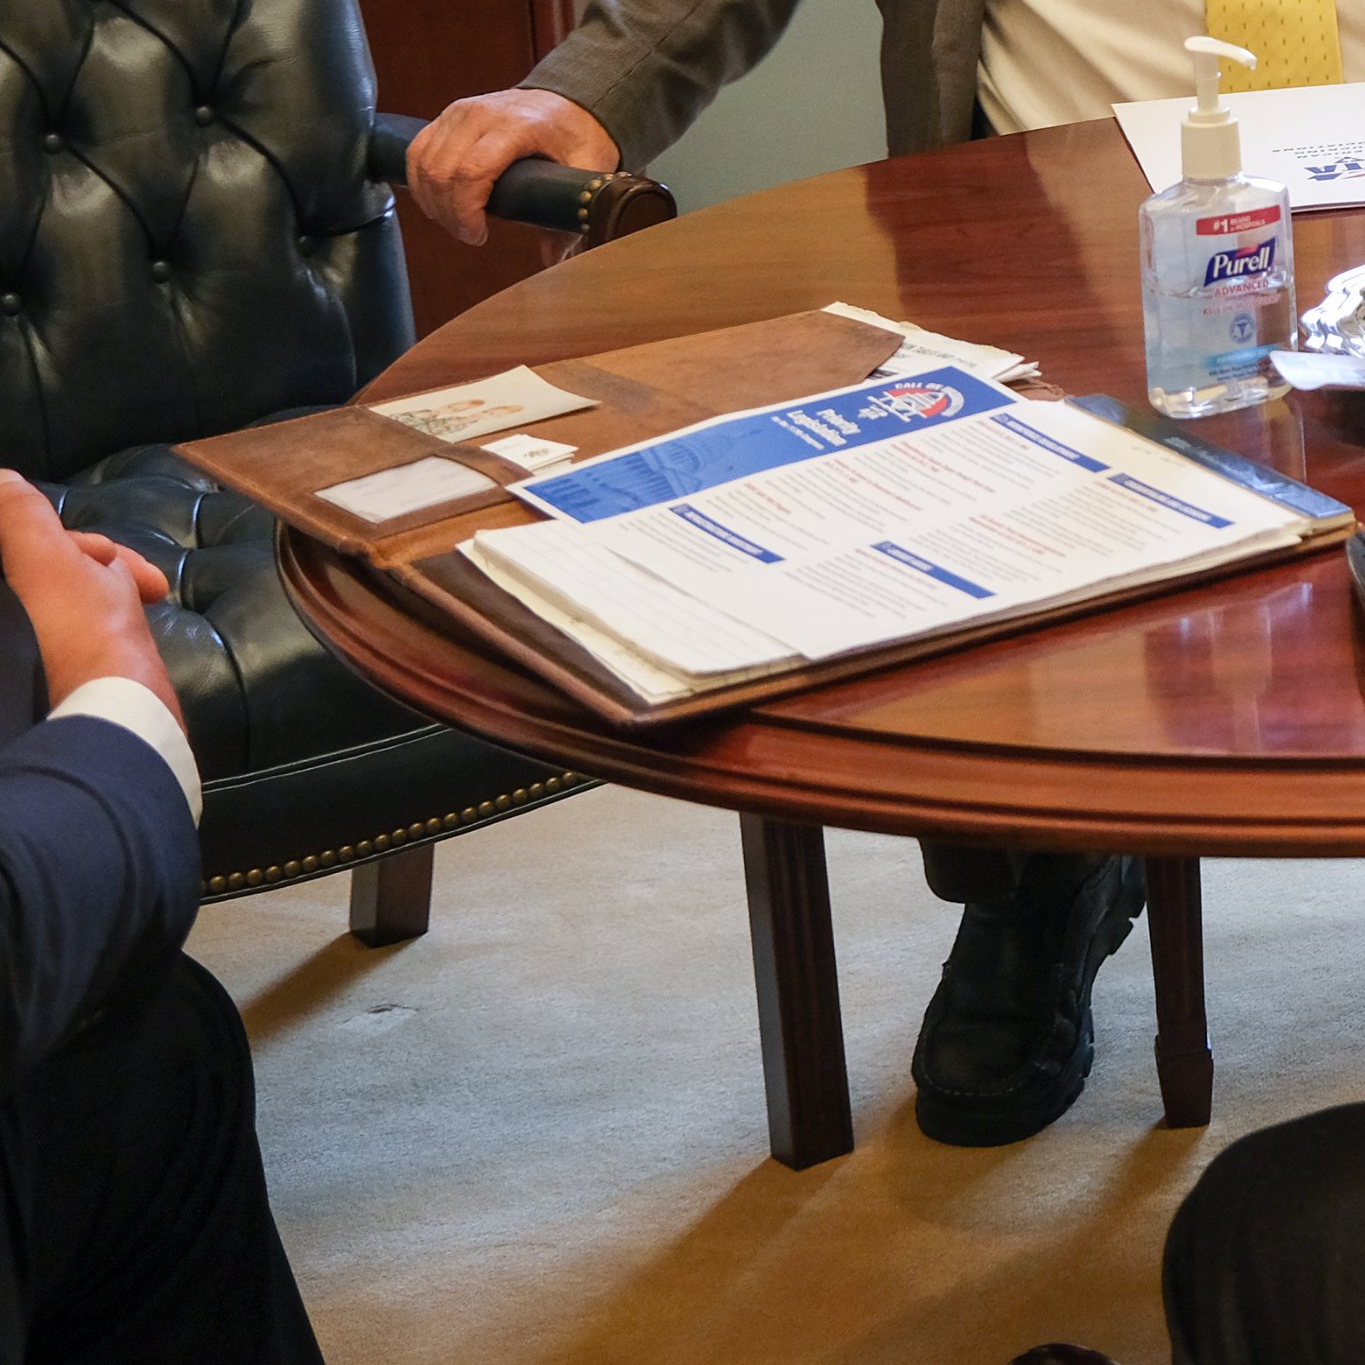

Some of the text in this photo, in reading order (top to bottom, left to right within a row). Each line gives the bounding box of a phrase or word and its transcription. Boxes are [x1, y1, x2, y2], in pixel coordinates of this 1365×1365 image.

[1214, 220, 1228, 233] #1
[1213, 247, 1270, 279] Purell
[1215, 281, 1269, 297] ADVANCED
